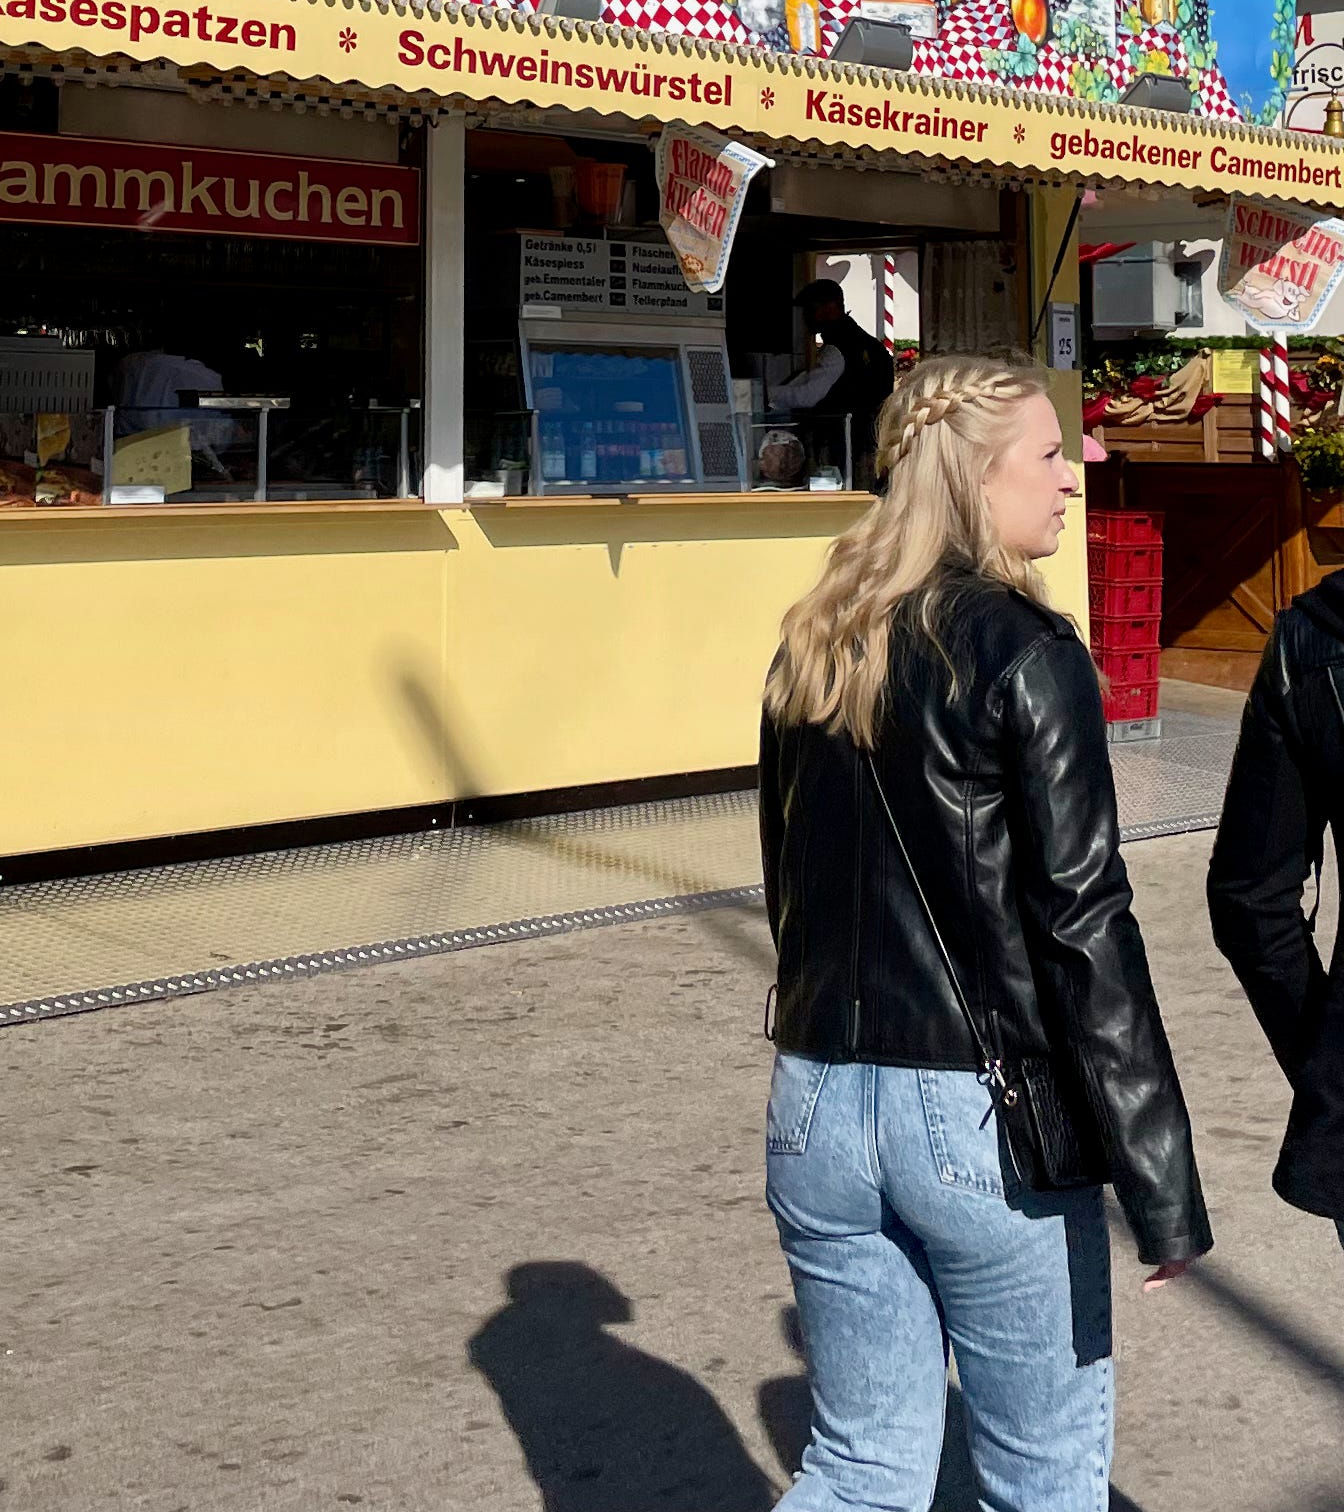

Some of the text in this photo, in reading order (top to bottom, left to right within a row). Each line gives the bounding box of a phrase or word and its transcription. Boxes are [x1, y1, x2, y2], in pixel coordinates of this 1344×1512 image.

[398, 28, 734, 107] Schweinswürstel
[805, 89, 989, 143] Käsekrainer
[1050, 128, 1202, 170] gebackener
[1210, 146, 1342, 189] Camembert
[525, 239, 573, 253] Getränke
[524, 256, 585, 271] Käsespiess
